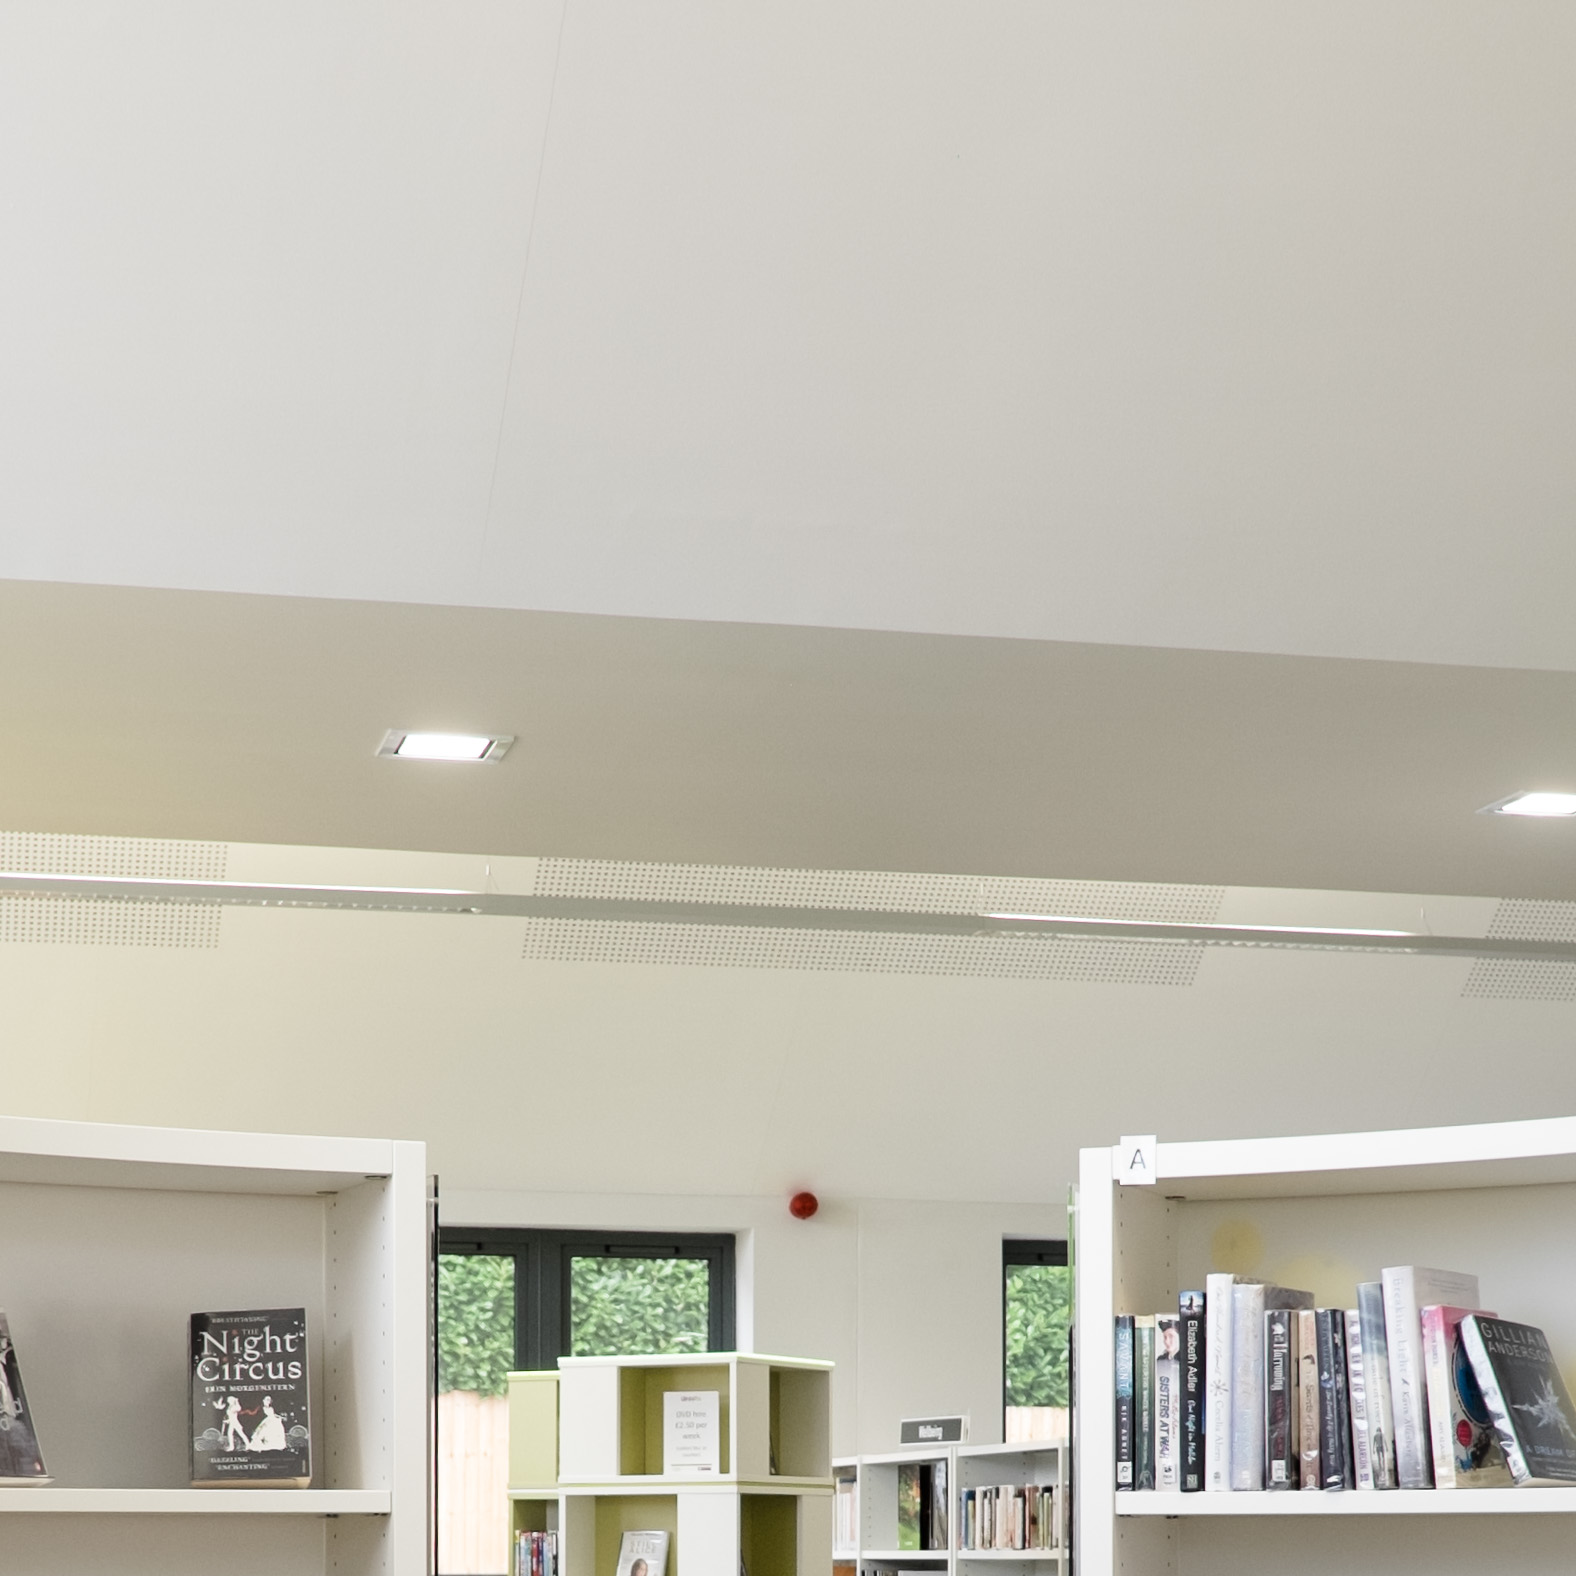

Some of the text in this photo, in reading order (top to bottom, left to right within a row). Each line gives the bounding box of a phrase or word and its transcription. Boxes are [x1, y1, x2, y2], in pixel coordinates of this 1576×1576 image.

[1129, 1148, 1146, 1169] A
[200, 1325, 299, 1361] Night
[1480, 1322, 1549, 1349] GILLIAN
[197, 1357, 303, 1381] Circus
[1118, 1333, 1130, 1389] SAVANT
[1186, 1320, 1198, 1392] Elizabeth Adler
[1159, 1376, 1170, 1417] SISTERS
